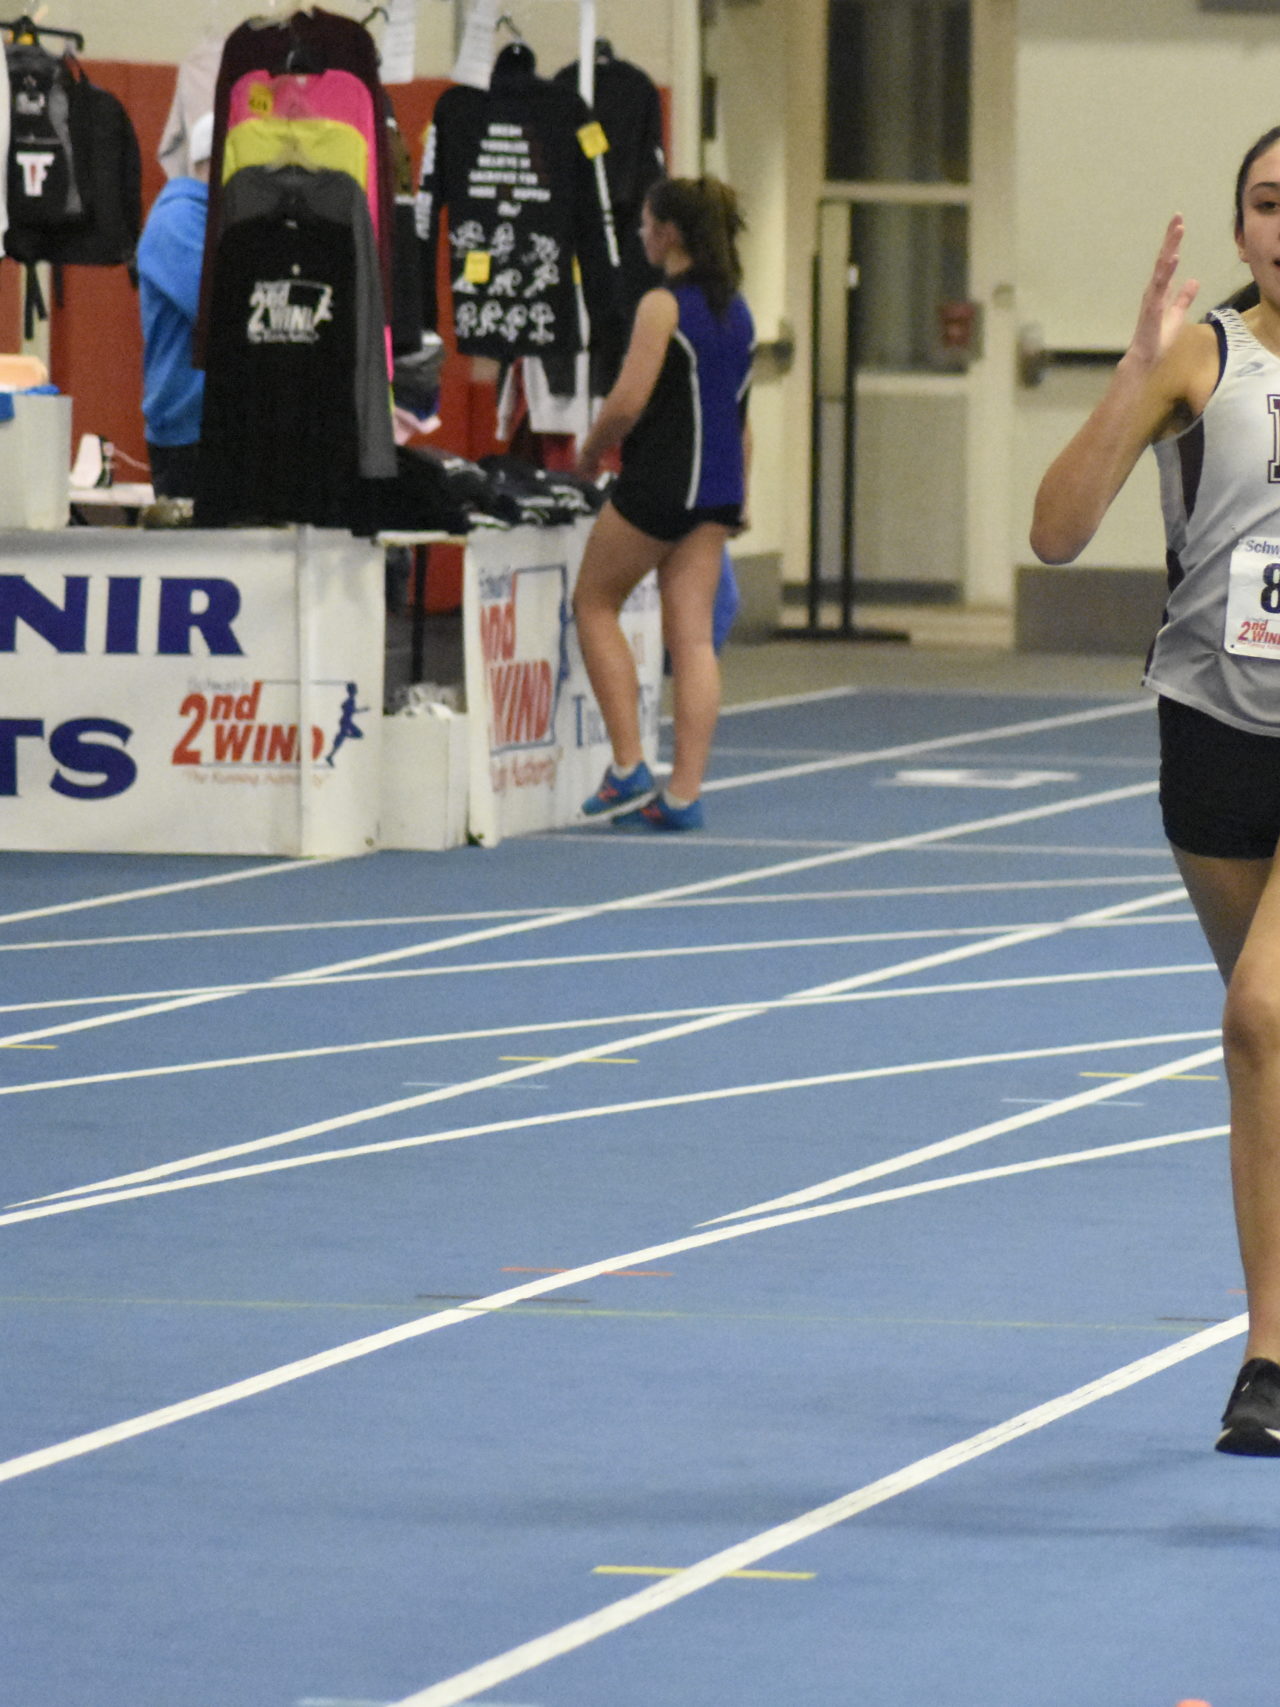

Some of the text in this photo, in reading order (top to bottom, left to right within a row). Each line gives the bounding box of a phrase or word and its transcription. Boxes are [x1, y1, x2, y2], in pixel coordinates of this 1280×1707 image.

[0, 574, 246, 656] NIR
[1238, 619, 1268, 641] 2nd
[171, 680, 263, 766] 2nd
